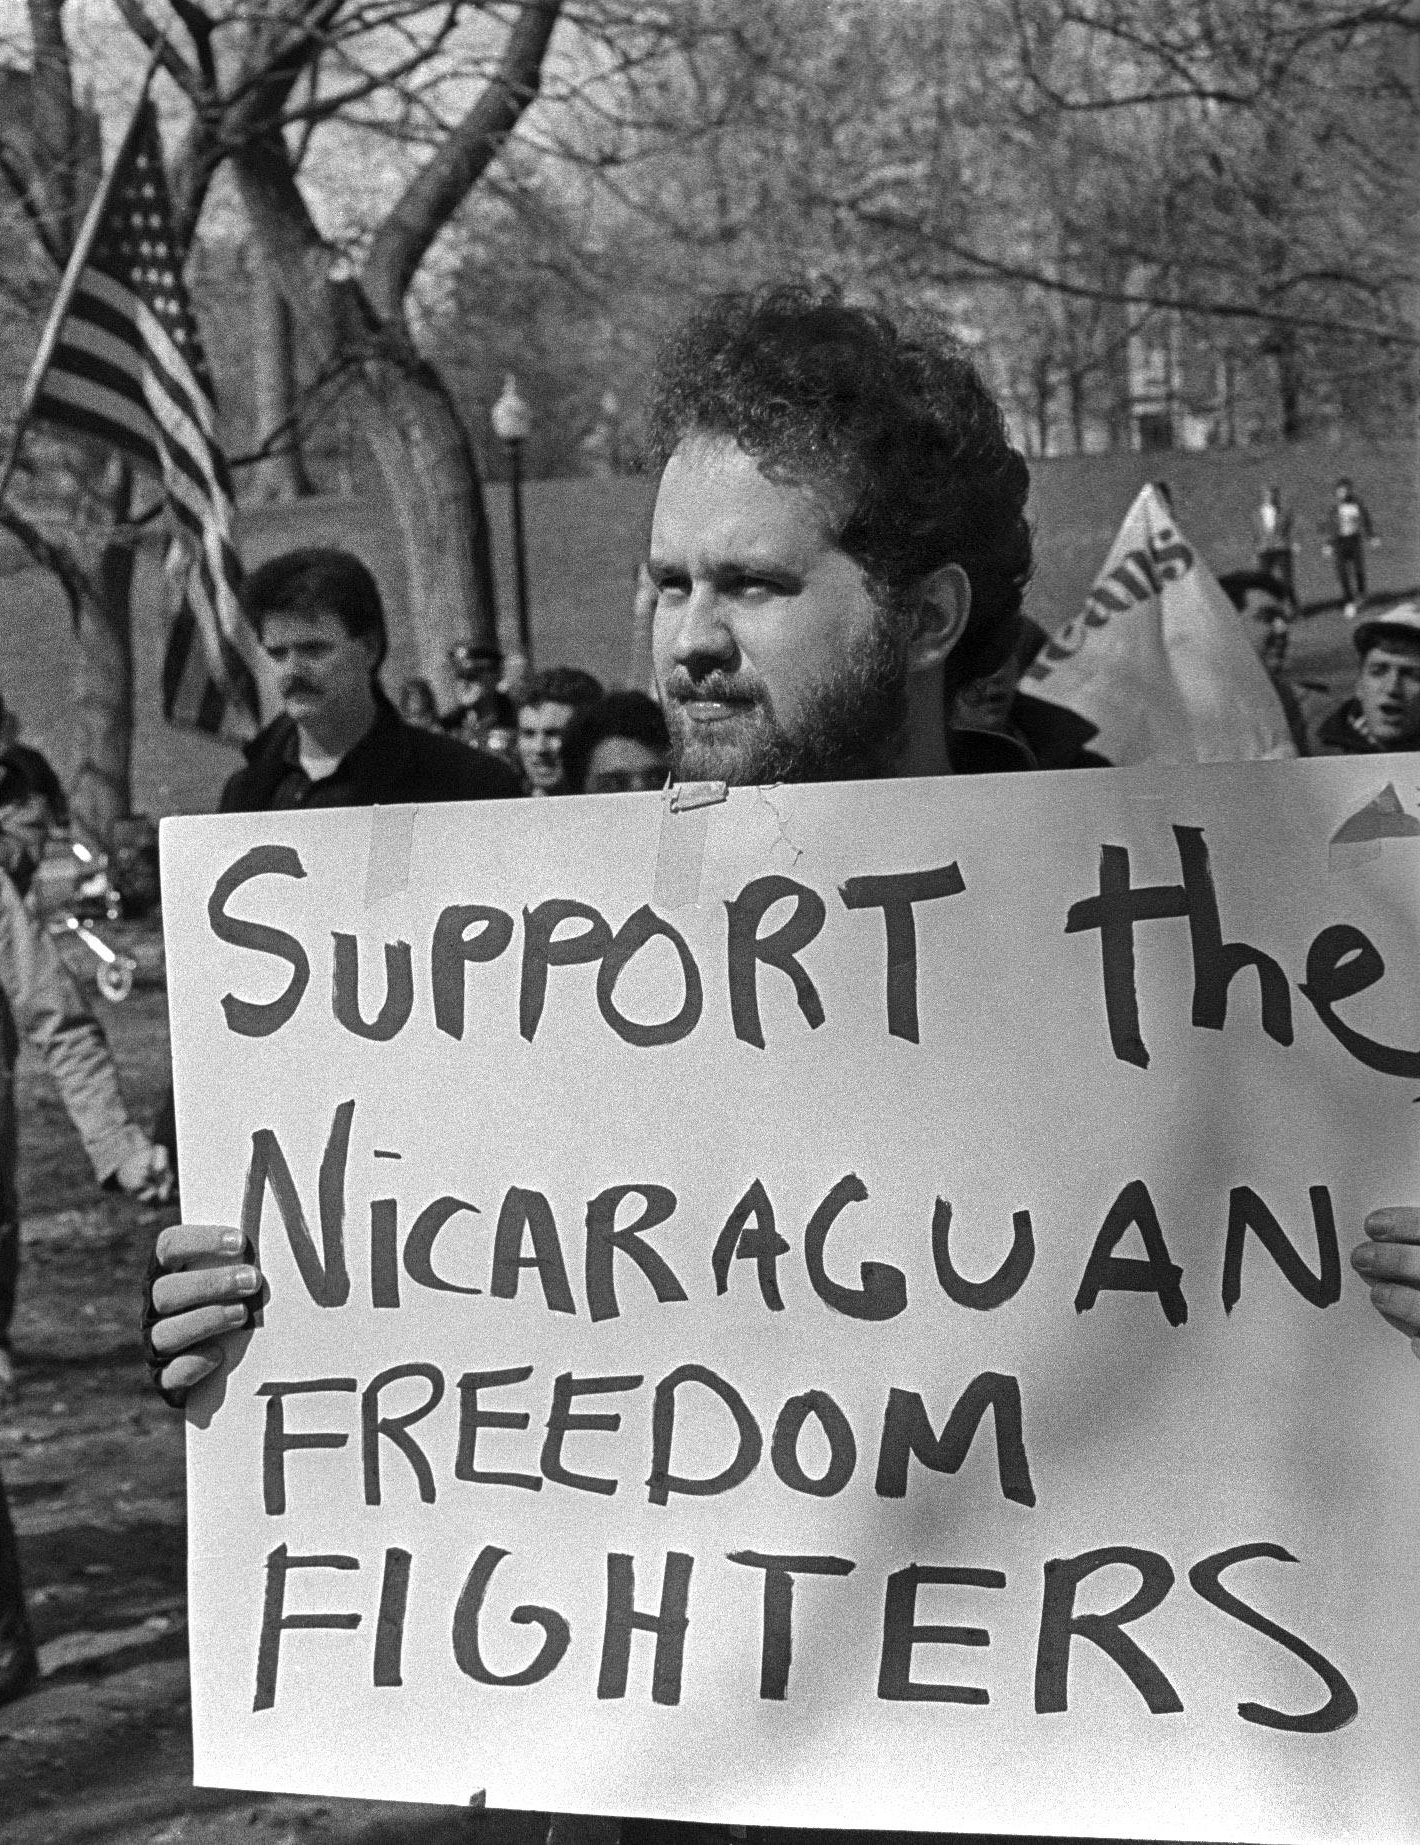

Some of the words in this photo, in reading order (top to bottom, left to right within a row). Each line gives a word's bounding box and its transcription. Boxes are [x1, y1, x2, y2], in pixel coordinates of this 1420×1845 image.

[207, 844, 966, 1049] SUPPORT
[1064, 825, 1420, 1078] the
[255, 1362, 1036, 1516] FREEDOM
[252, 1542, 1359, 1734] FIGHTERS
